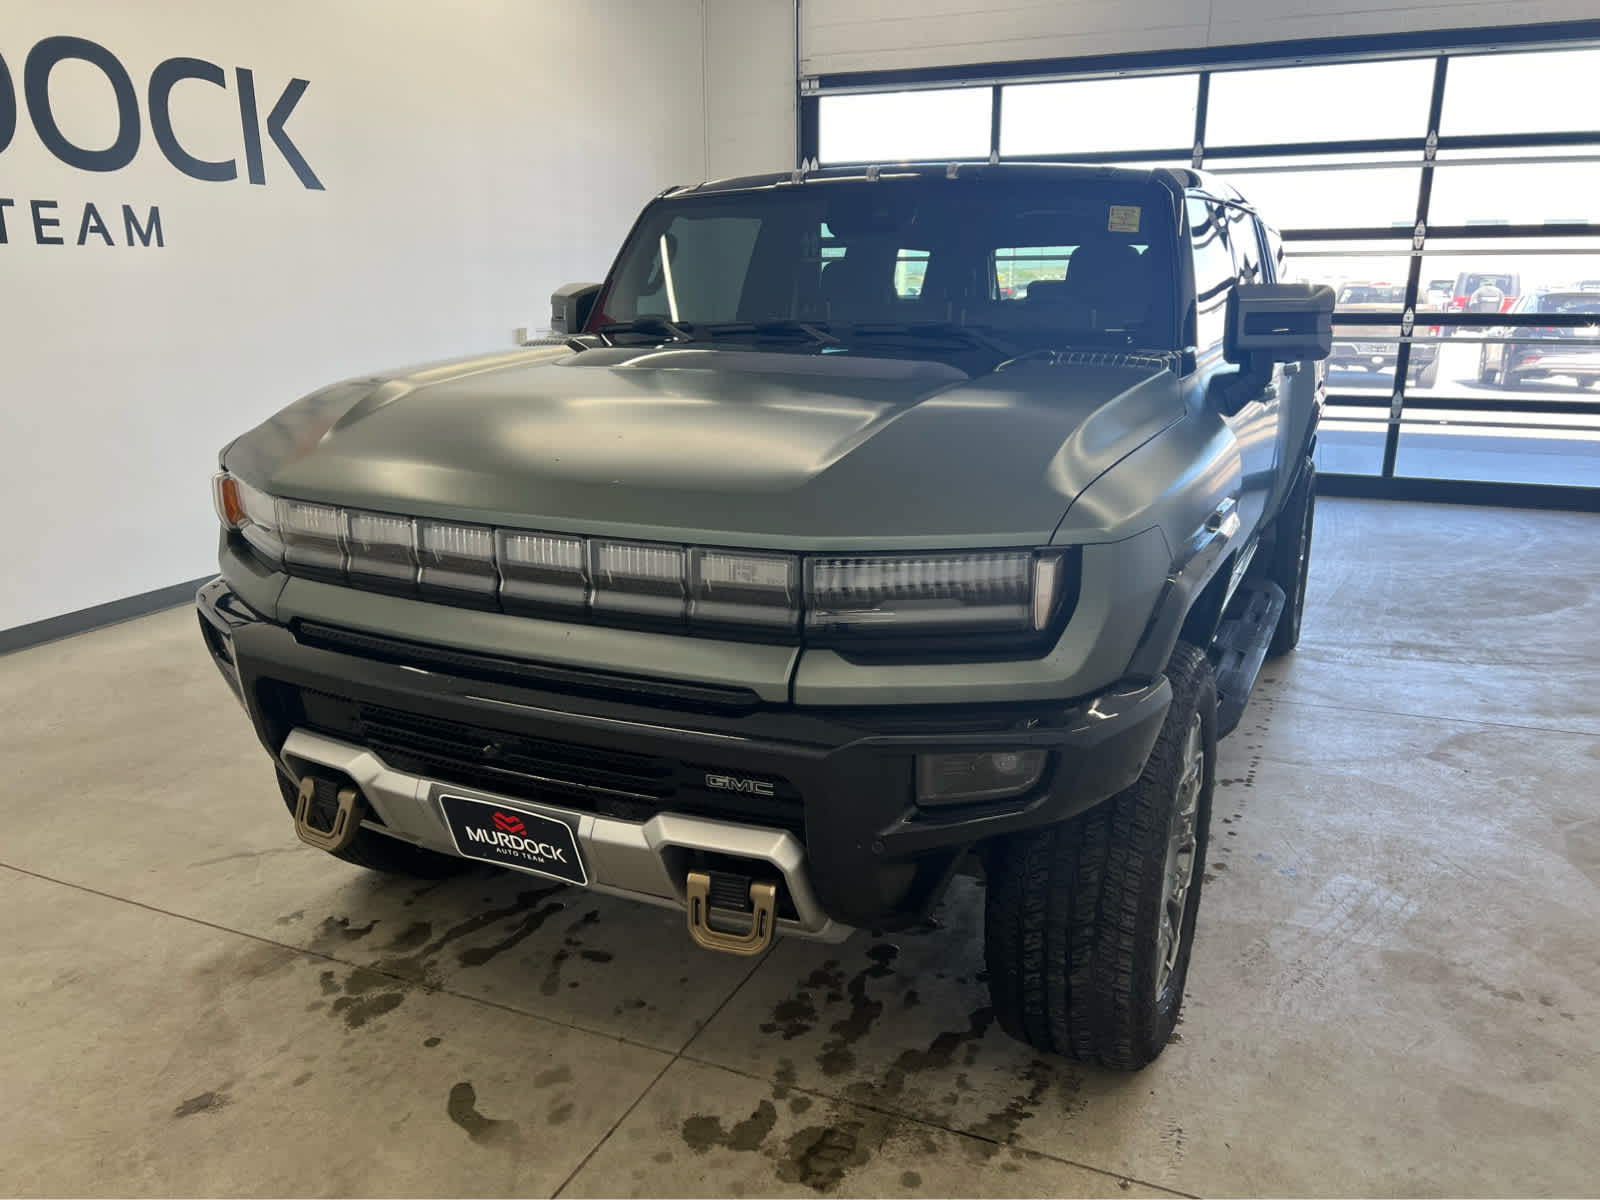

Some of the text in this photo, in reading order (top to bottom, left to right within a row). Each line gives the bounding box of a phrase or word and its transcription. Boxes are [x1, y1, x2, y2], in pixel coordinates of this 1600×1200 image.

[705, 774, 775, 796] GMC
[465, 825, 568, 864] MURDOCK
[496, 847, 545, 864] AUTO TEAM
